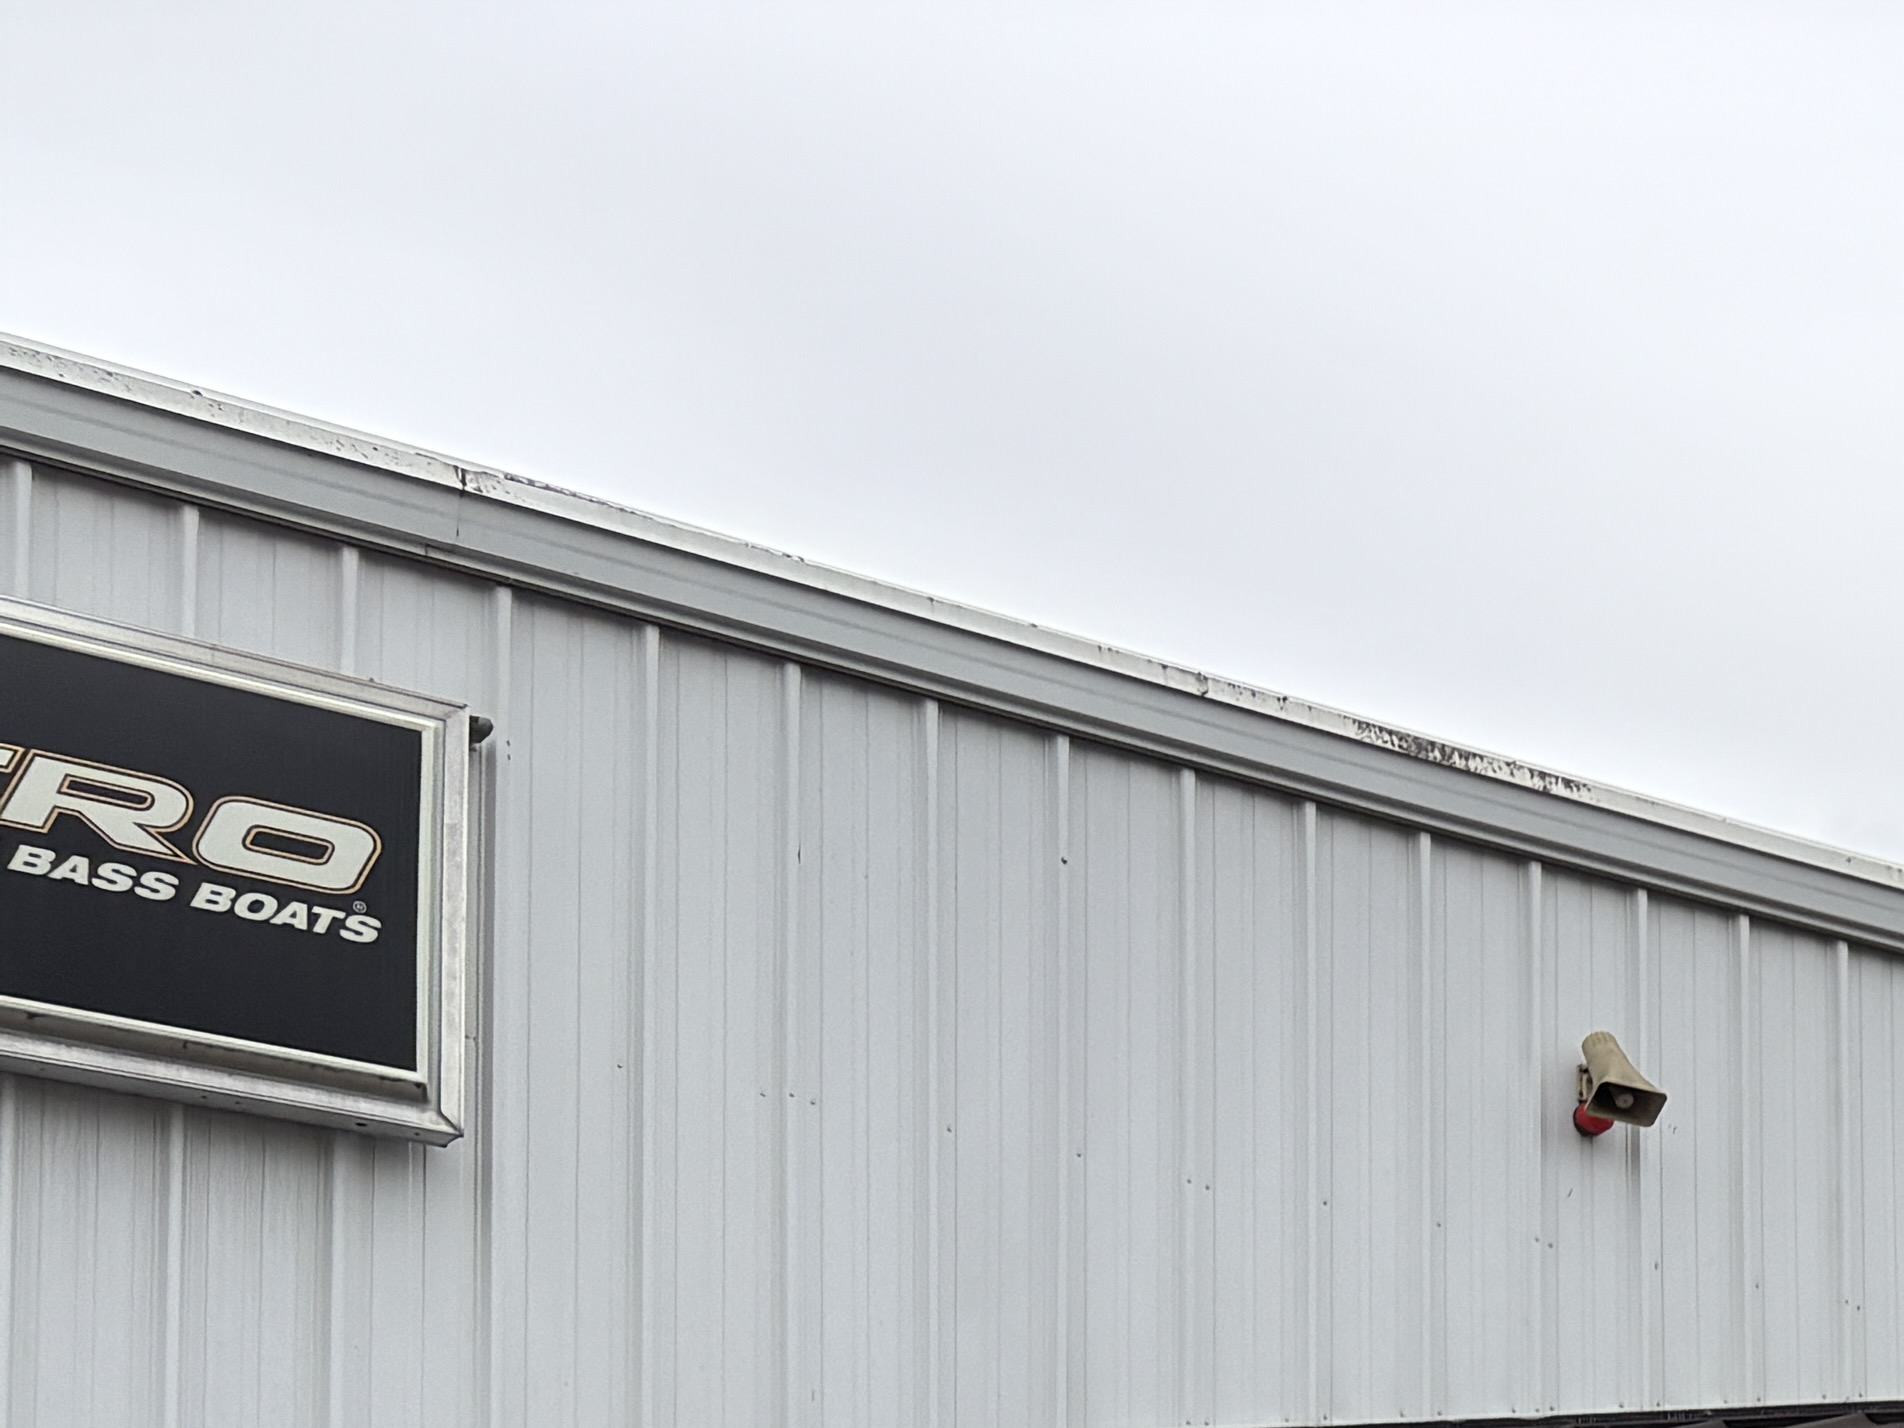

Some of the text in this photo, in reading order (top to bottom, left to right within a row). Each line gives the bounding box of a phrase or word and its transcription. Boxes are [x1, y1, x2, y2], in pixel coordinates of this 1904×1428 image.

[0, 743, 382, 895] RO
[7, 844, 382, 943] BASS BOATS
